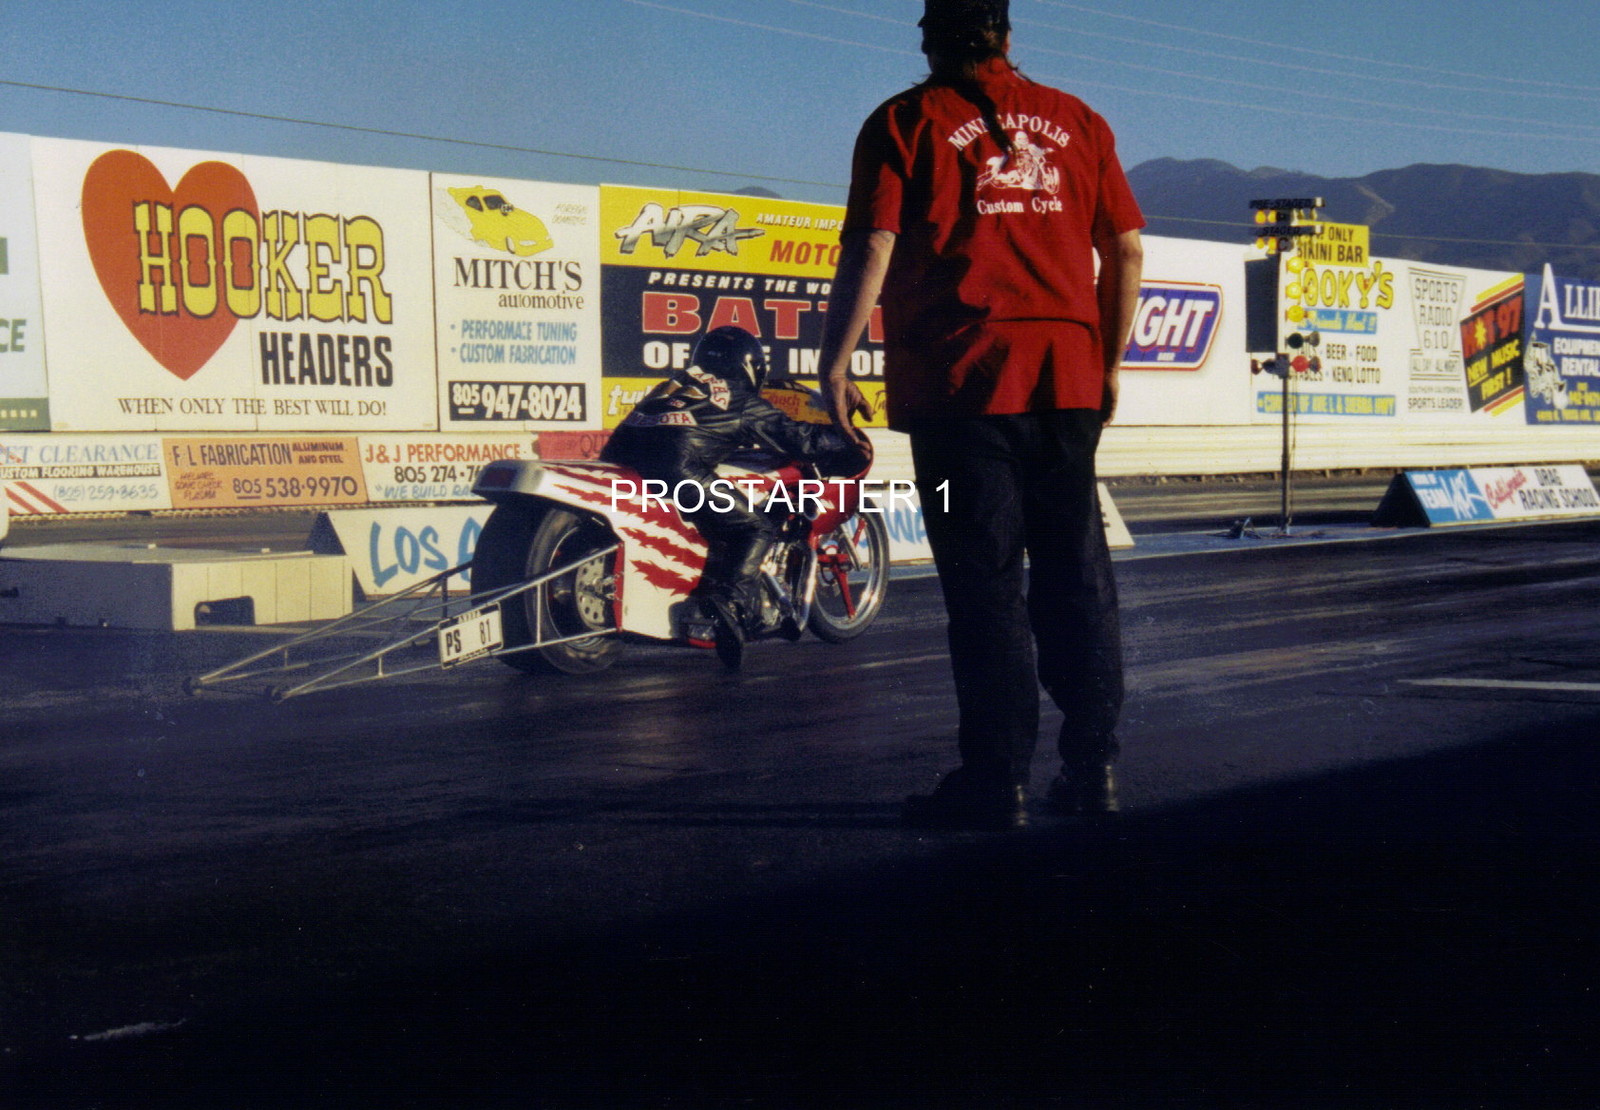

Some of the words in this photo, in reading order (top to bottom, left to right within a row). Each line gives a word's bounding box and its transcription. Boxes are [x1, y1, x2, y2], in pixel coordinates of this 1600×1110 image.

[947, 113, 1070, 152] MINAPOLIS
[977, 199, 1024, 215] Custom
[756, 213, 811, 228] AMATEUR
[1329, 226, 1354, 242] ONLY
[132, 200, 393, 324] HOOKER
[1338, 245, 1363, 263] BAR
[453, 257, 583, 292] MITCH'S
[649, 272, 754, 289] PRESENTS
[765, 279, 797, 294] THE
[1299, 261, 1394, 310] OOKY'S
[1415, 278, 1458, 303] SPORTS
[498, 290, 584, 310] automotive
[1419, 304, 1453, 326] RADIO
[537, 321, 577, 342] TUNING
[1424, 330, 1449, 349] 610
[259, 332, 394, 387] HEADERS
[460, 342, 505, 364] CUSTOM
[509, 345, 576, 365] FABRICATION
[643, 341, 691, 369] OF
[119, 397, 174, 415] WHEN
[180, 397, 226, 416] ONLY
[234, 398, 267, 416] THE
[274, 399, 315, 416] BEST
[317, 400, 354, 416] WILL
[358, 400, 387, 416] DO!
[453, 383, 480, 407] 805
[481, 384, 582, 420] 947-8024
[39, 443, 159, 463] CLEARANCE
[200, 443, 292, 466] FABRICATION
[293, 442, 344, 452] ALUMINUM
[408, 443, 521, 462] PERFORMANCE
[298, 455, 317, 464] AND
[319, 454, 343, 464] STEEL
[42, 466, 94, 478] FLOORING
[97, 464, 160, 477] WAREHOUSE
[395, 466, 426, 483] 805
[232, 478, 262, 494] 805
[412, 485, 447, 498] BUILD
[369, 521, 448, 588] LOS
[445, 628, 461, 657] PS
[479, 618, 492, 645] 81
